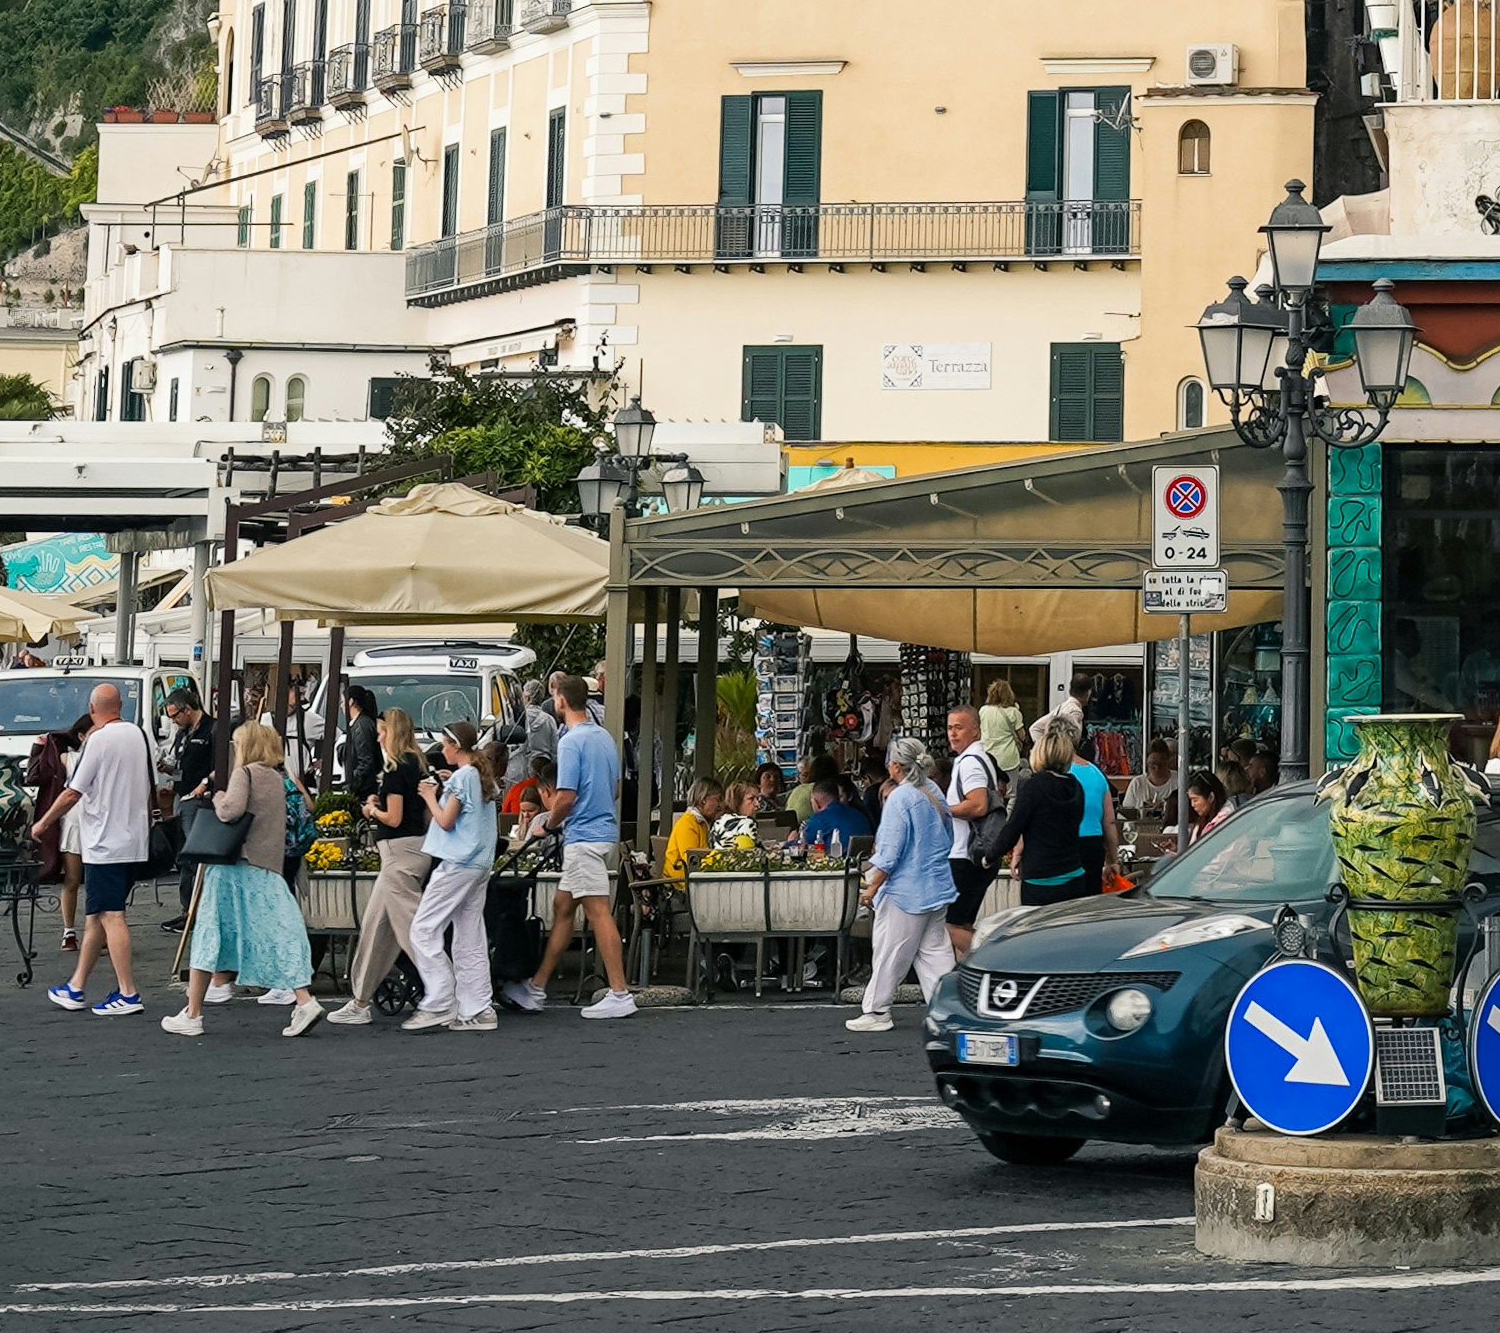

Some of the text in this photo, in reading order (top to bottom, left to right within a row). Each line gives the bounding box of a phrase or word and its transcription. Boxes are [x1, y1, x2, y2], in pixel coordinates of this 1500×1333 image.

[928, 359, 988, 373] Terrazza
[1186, 546, 1208, 560] 24
[1161, 575, 1182, 584] tutta
[1186, 575, 1195, 584] la
[1164, 586, 1173, 596] al
[449, 658, 478, 670] TAXI
